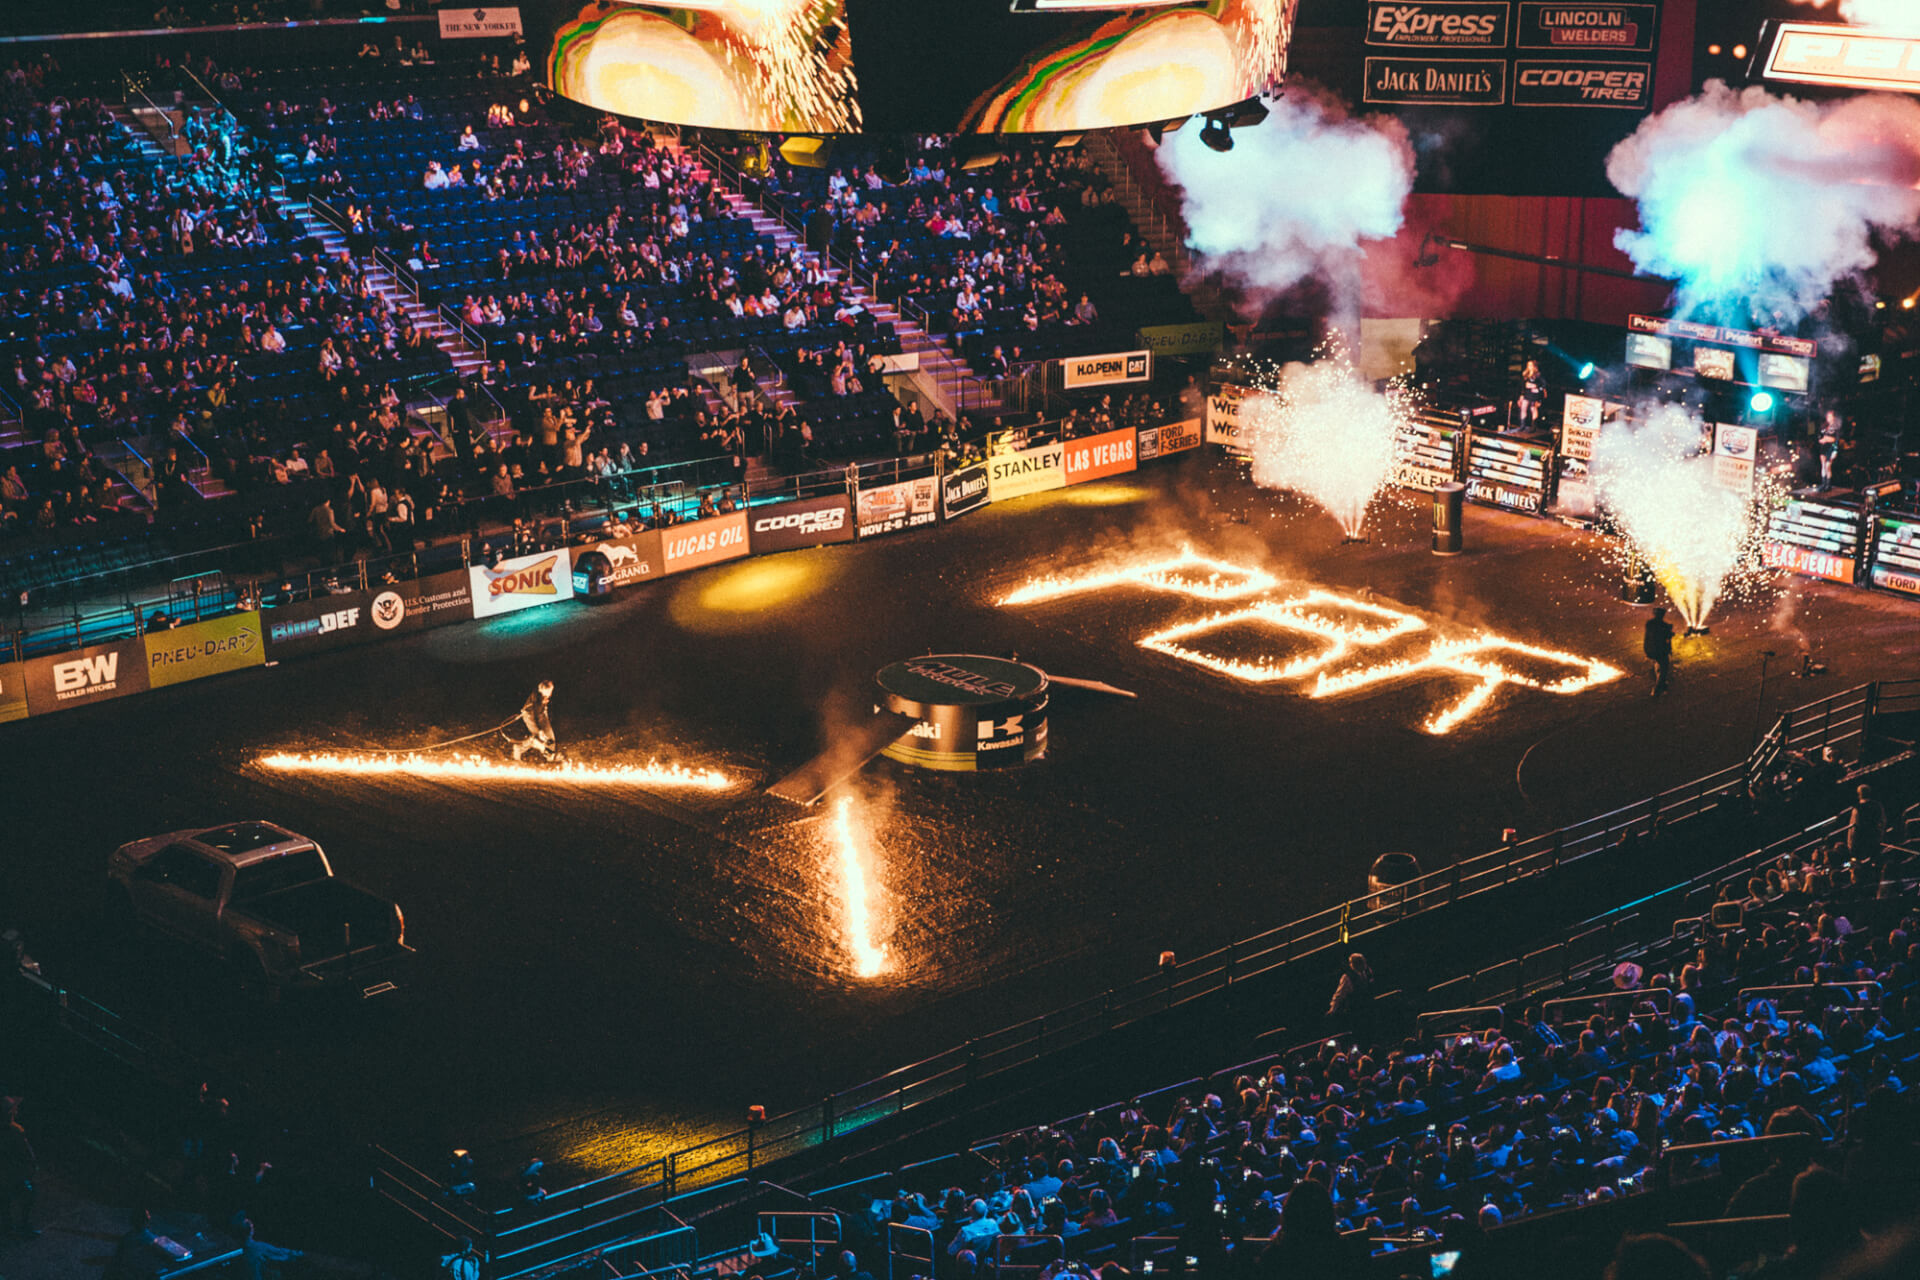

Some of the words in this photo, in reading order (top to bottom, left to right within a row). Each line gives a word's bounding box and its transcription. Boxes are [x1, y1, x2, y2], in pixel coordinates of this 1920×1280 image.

[445, 24, 462, 32] THE
[463, 23, 480, 32] NEW
[484, 22, 516, 31] YORKER
[1544, 11, 1622, 27] LINCOLN
[1561, 29, 1627, 42] WELDERS
[1783, 35, 1920, 71] PB
[1377, 66, 1419, 91] JACK
[1425, 68, 1492, 92] DANIEL'S
[1519, 69, 1645, 88] COOPER
[1580, 86, 1641, 101] TIRES
[1129, 359, 1146, 374] CAT
[1160, 425, 1184, 441] FORD
[1160, 433, 1199, 453] F-SERIES
[1067, 448, 1090, 473] LAS
[1092, 439, 1134, 467] VEGAS
[993, 452, 1062, 480] STANLEY
[945, 486, 961, 504] JACK
[1466, 479, 1494, 500] JACK
[754, 508, 846, 532] COOPER
[799, 519, 844, 535] TIRES
[860, 523, 883, 537] NOV
[909, 512, 936, 526] 2016
[667, 534, 715, 560] LUCAS
[719, 525, 744, 548] OIL
[1771, 545, 1797, 569] LAS
[1800, 552, 1844, 578] VEGAS
[613, 563, 650, 581] GRAND
[489, 568, 553, 597] SONIC
[1889, 576, 1917, 591] FORD
[419, 591, 452, 605] Customs
[452, 586, 467, 598] and
[432, 597, 471, 611] Protection
[152, 633, 250, 668] PNEU-DART
[56, 687, 86, 701] TRAILER
[86, 681, 117, 694] HITCHES
[977, 734, 1024, 752] Kawasaki
